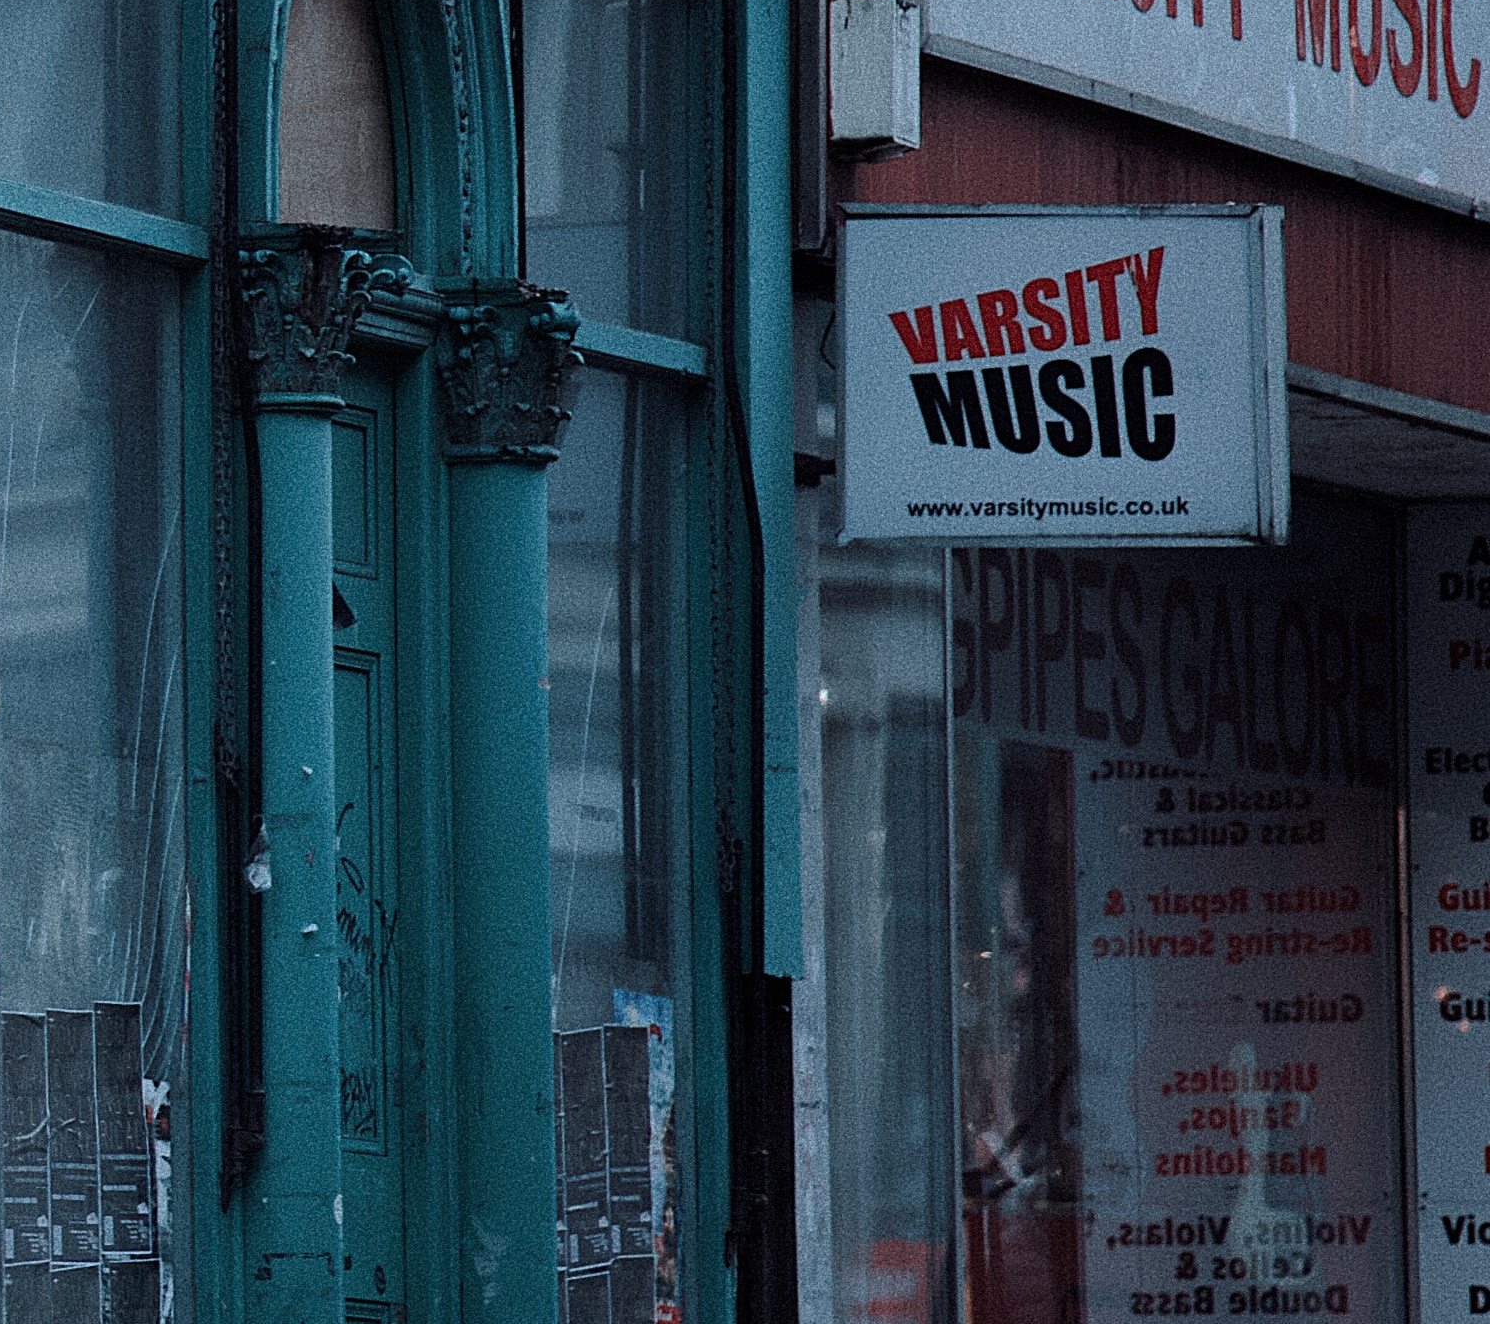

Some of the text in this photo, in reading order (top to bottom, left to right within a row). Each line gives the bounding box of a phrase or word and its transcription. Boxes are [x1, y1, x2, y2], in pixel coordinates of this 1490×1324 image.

[890, 246, 1165, 365] VARSITY
[910, 346, 1176, 461] MUSIC
[907, 495, 1190, 521] www.varsitymusic.co.uk
